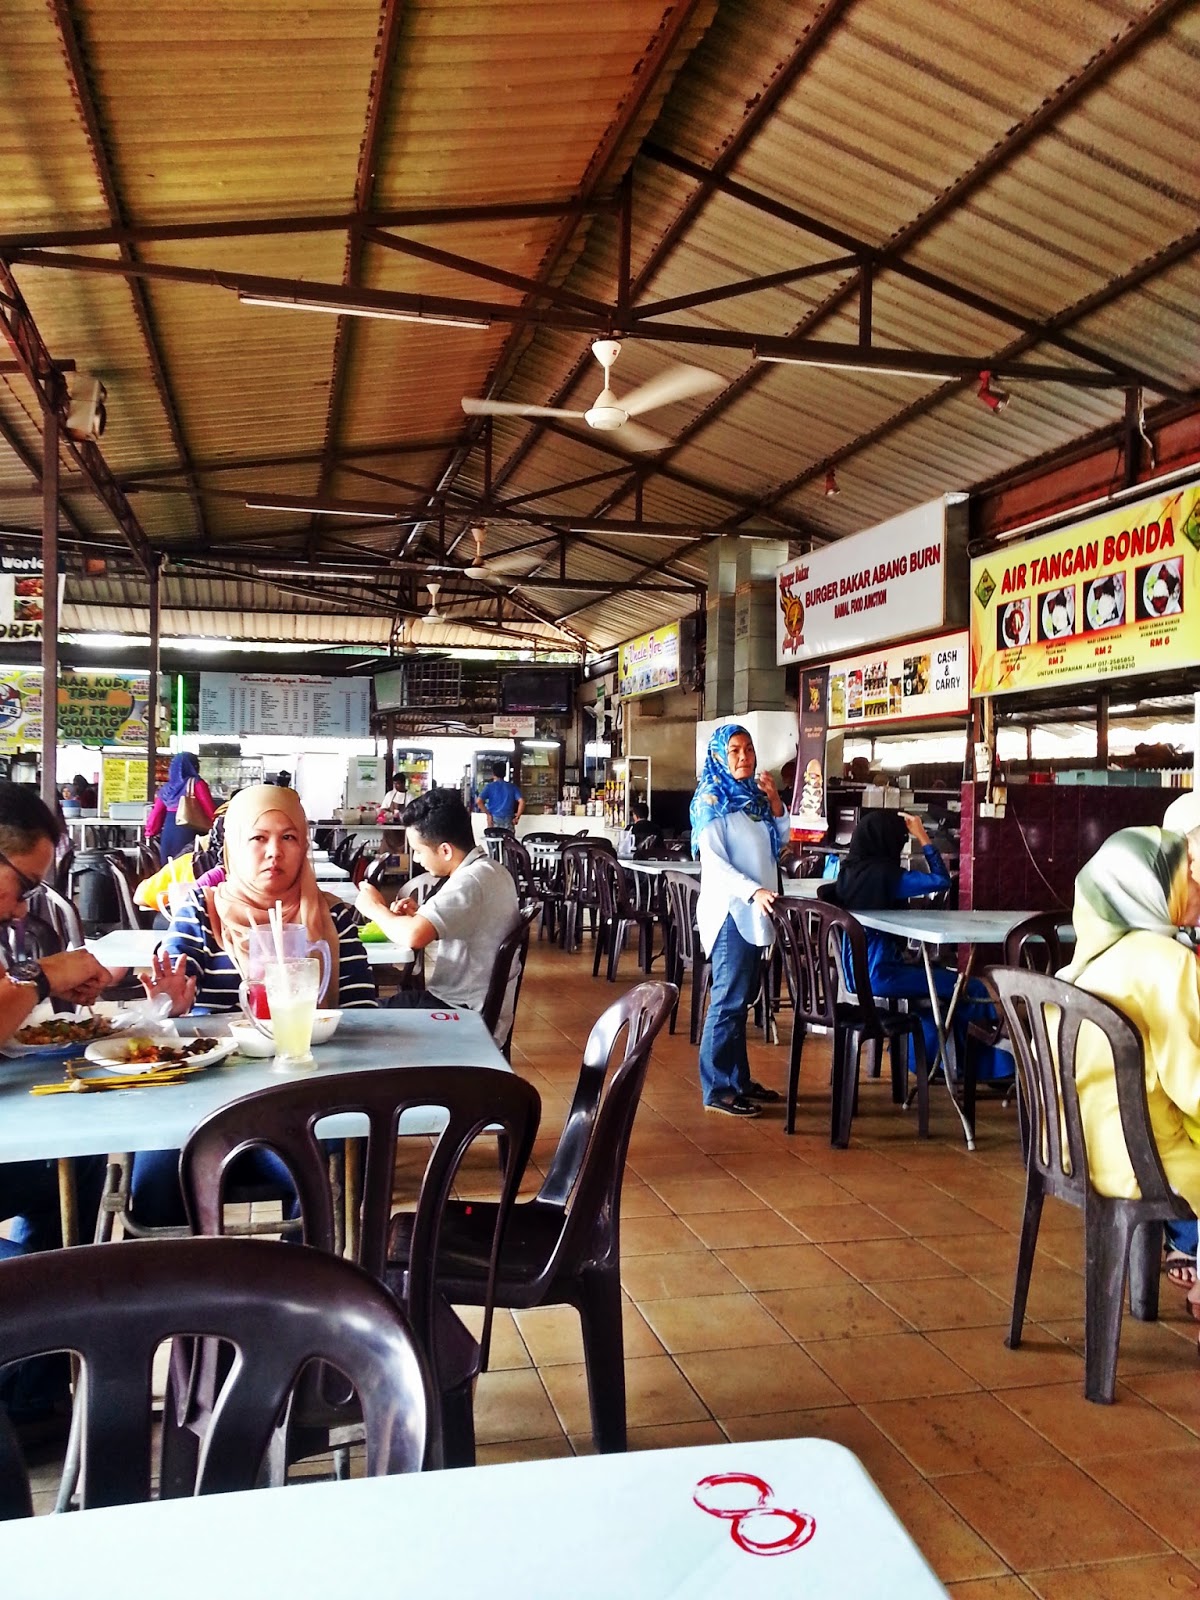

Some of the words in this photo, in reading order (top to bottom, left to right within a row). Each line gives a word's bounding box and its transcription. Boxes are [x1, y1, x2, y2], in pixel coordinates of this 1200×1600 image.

[1001, 563, 1027, 595] AIR
[1030, 540, 1099, 587] TANGAN
[1102, 517, 1176, 567] BONDA
[805, 583, 839, 609] BURGER
[839, 569, 871, 597] BAKAR
[871, 558, 908, 585] ABANG
[909, 543, 941, 572] BURN
[850, 597, 863, 614] FOOD
[863, 589, 887, 610] JUNCTION
[1149, 637, 1163, 648] RM
[1094, 646, 1106, 656] RM
[1107, 645, 1112, 654] 2
[937, 649, 958, 665] CASH
[1048, 657, 1059, 666] RM
[1060, 655, 1064, 664] 3
[944, 664, 950, 676] &
[1037, 669, 1054, 677] UNTUK
[1055, 664, 1082, 674] TEMPAHAN
[59, 677, 89, 688] HAR
[95, 677, 130, 689] KUEY
[935, 676, 961, 691] CARRY
[67, 687, 108, 699] TEOW
[59, 705, 84, 716] UEY
[88, 705, 130, 716] TEOW
[60, 716, 120, 727] GORENG
[65, 727, 115, 738] UDANG
[692, 1472, 817, 1556] 8
